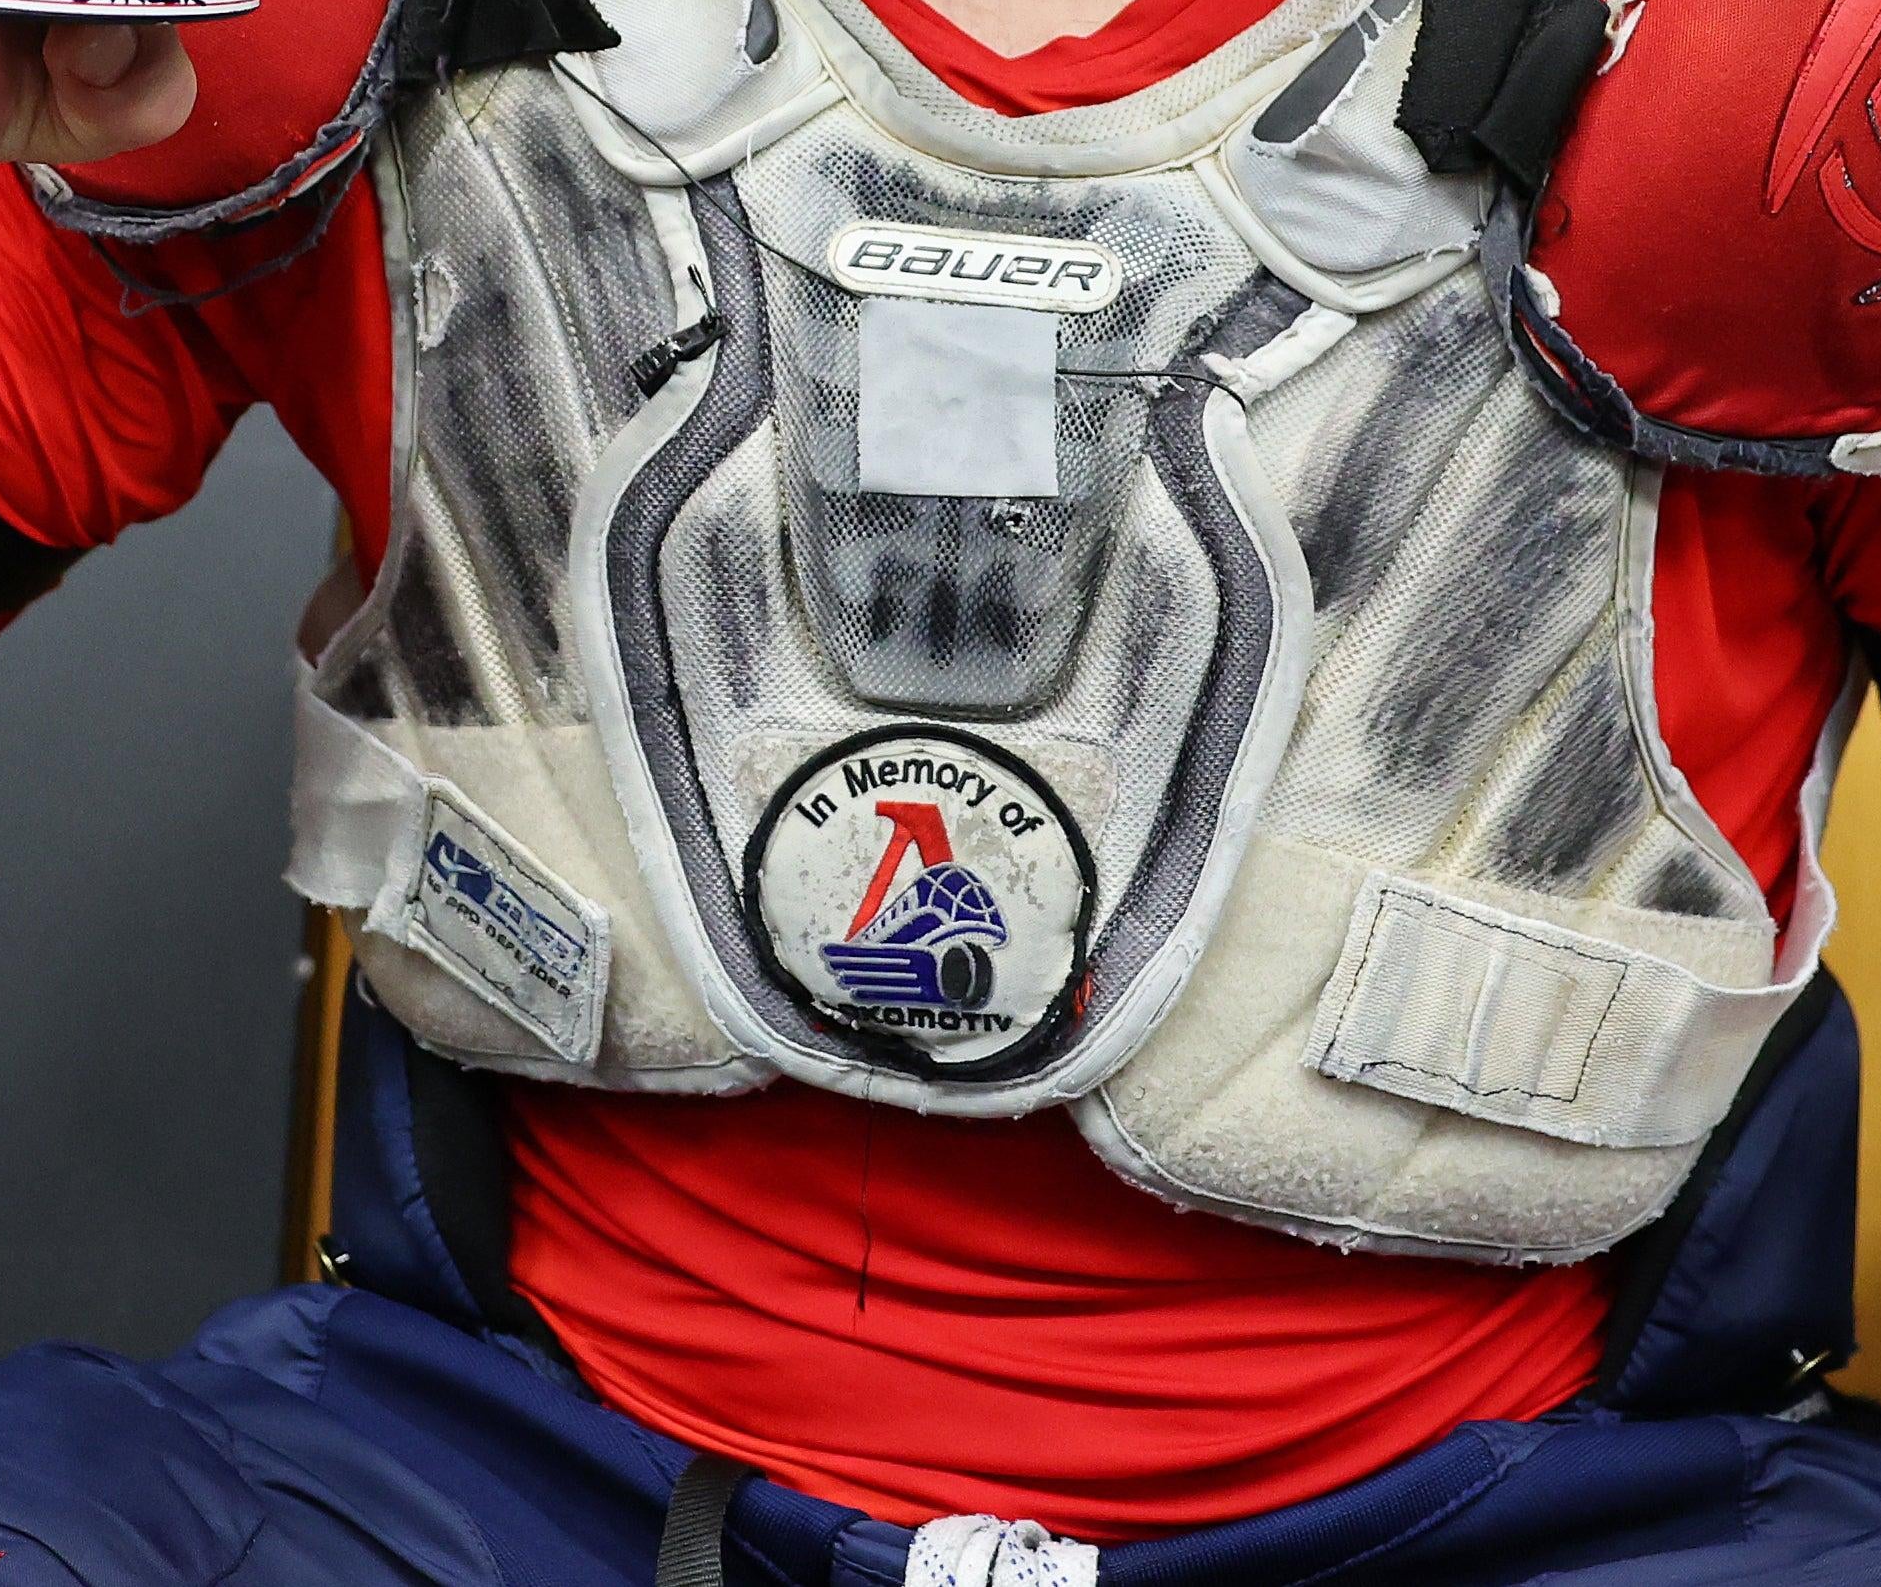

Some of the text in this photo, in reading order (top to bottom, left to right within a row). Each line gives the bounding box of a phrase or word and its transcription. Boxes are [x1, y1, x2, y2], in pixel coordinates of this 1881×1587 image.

[847, 239, 1104, 292] BAUER
[795, 757, 1045, 838] In Memory of
